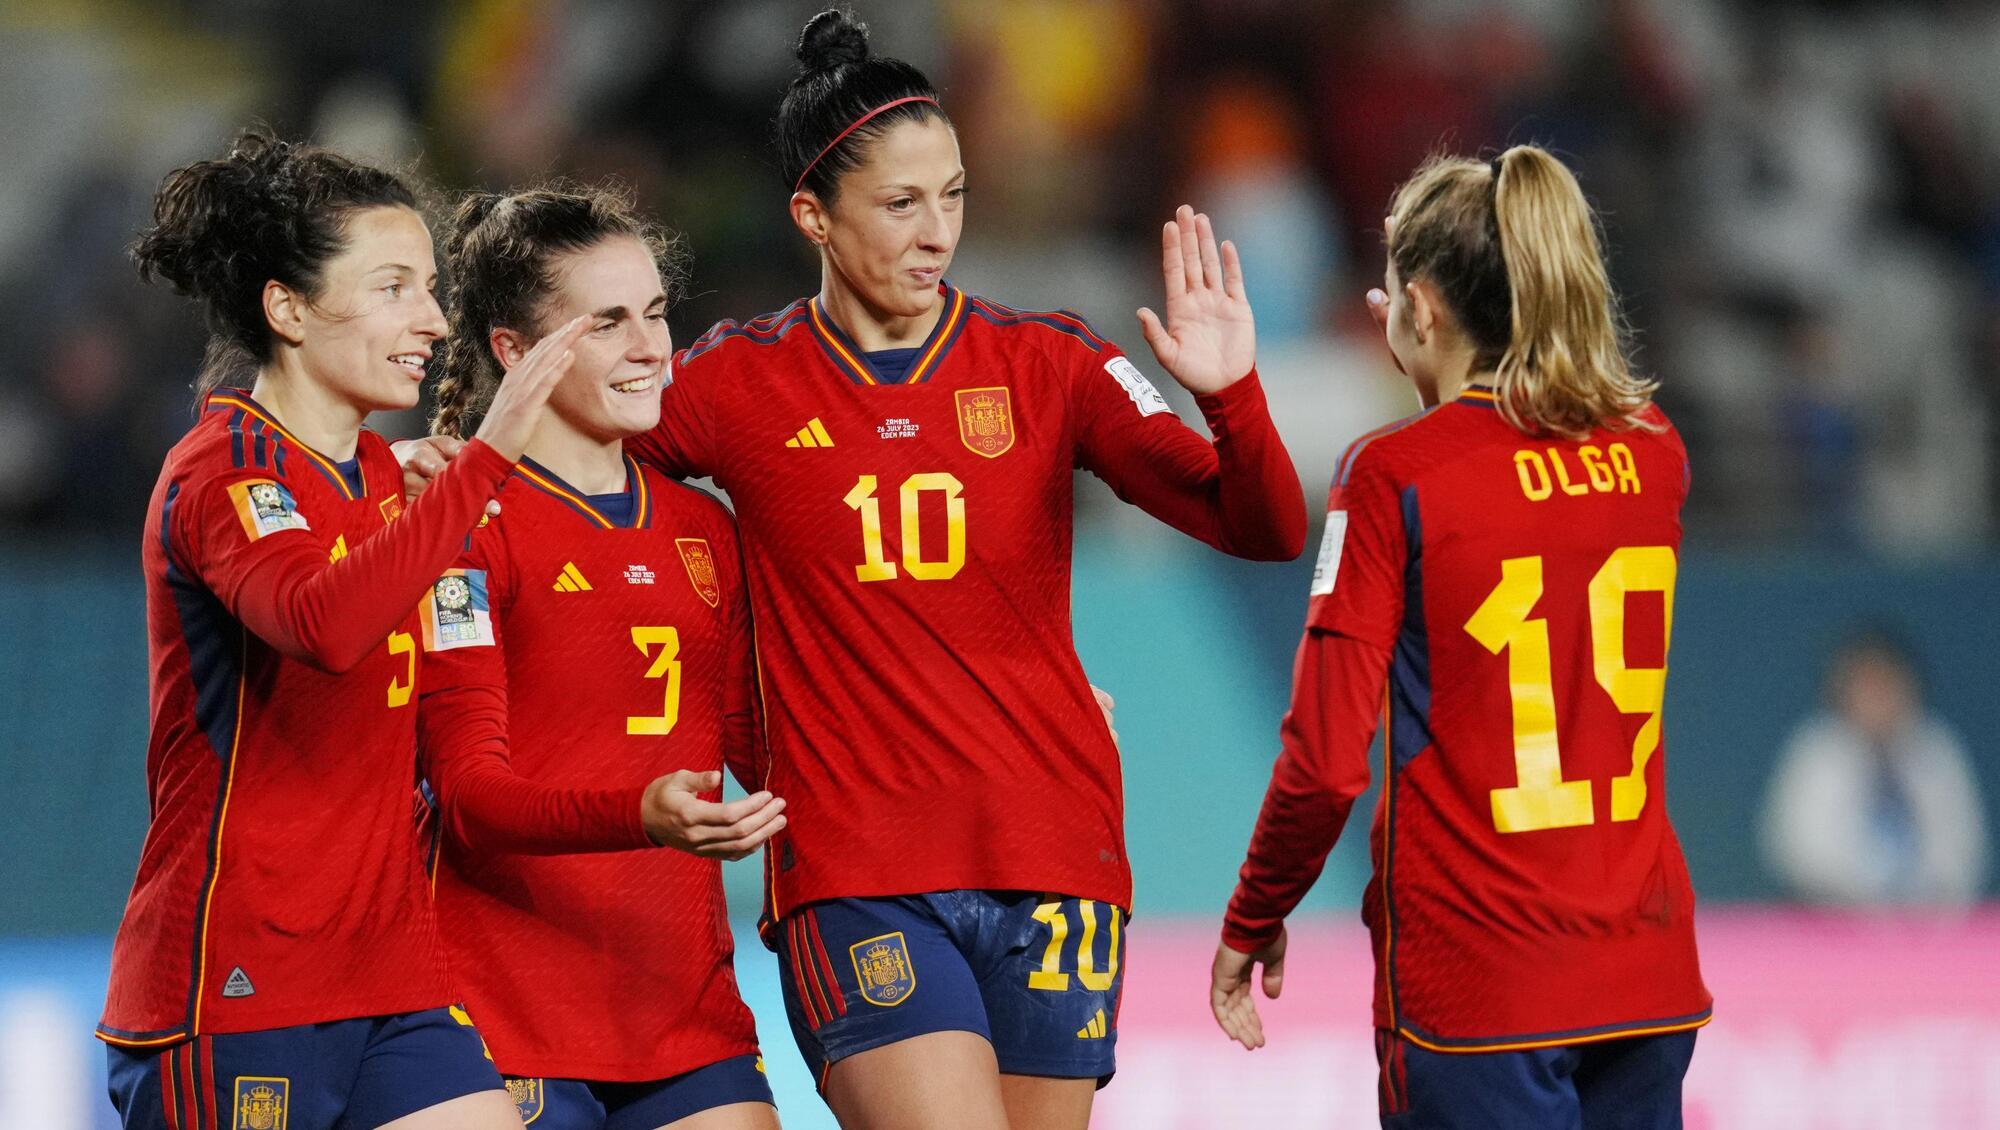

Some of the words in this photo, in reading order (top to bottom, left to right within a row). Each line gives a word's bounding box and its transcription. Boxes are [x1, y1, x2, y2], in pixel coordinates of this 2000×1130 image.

[1516, 444, 1641, 501] OLGA
[843, 473, 966, 582] 10
[387, 631, 416, 708] 5
[627, 626, 680, 735] 3
[1464, 546, 1677, 833] 19
[1028, 899, 1120, 992] 10
